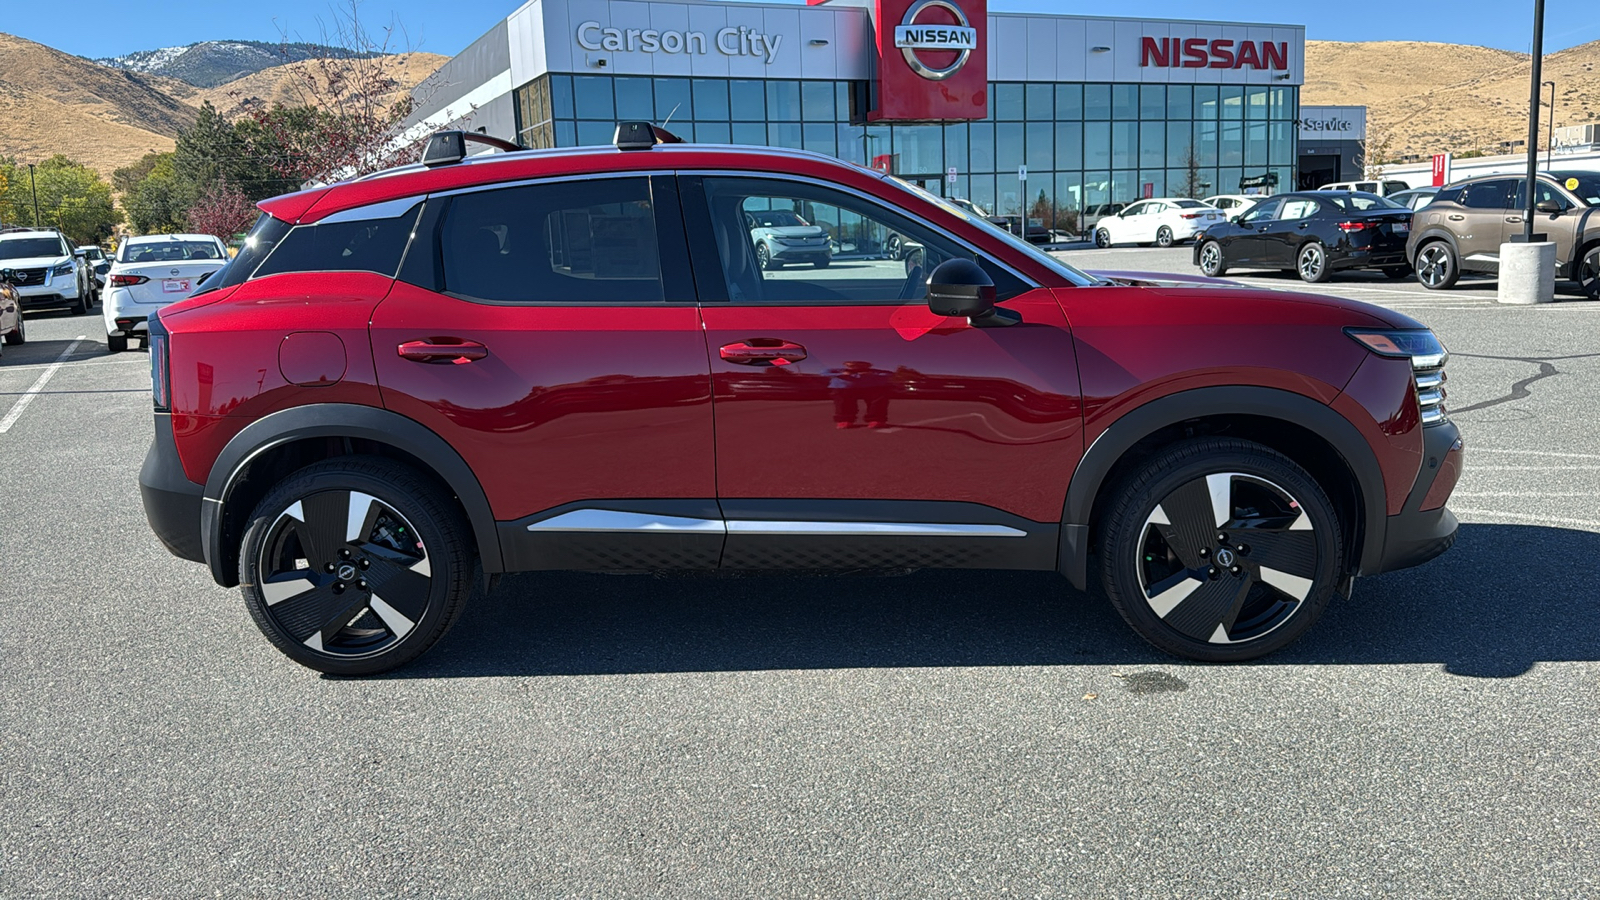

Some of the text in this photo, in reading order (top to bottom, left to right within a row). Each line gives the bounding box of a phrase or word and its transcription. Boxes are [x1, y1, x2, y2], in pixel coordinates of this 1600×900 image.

[577, 21, 783, 64] Carson City
[905, 30, 971, 44] NISSAN
[1141, 37, 1288, 70] NISSAN
[1304, 117, 1352, 131] Service
